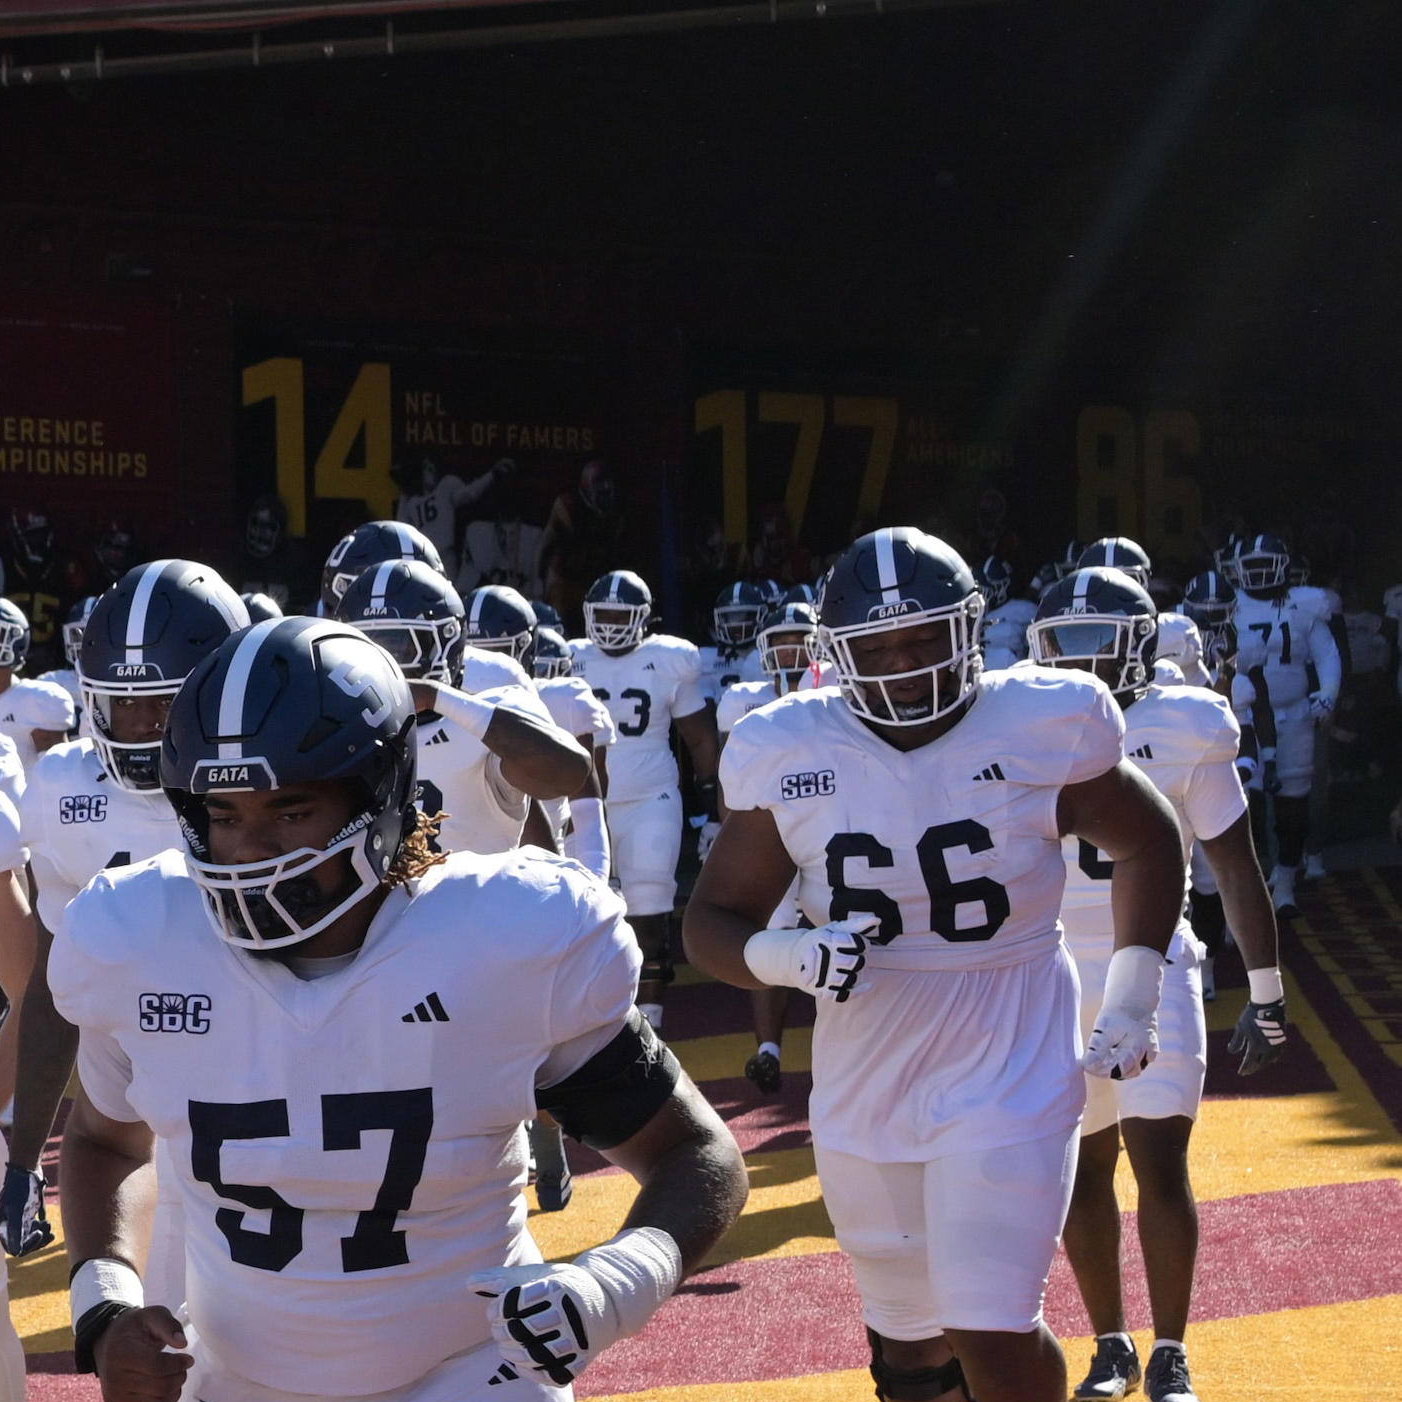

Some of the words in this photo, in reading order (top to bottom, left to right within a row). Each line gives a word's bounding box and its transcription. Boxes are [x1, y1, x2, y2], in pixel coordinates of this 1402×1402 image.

[405, 391, 446, 416] NFL
[242, 357, 400, 539] 14
[405, 420, 463, 446] HALL
[471, 424, 499, 448] OF
[506, 423, 595, 451] FAMERS
[694, 389, 900, 558] 177
[1076, 406, 1203, 556] 86
[363, 607, 389, 616] GATA
[879, 603, 909, 618] GATA
[1247, 622, 1293, 666] 71
[116, 665, 147, 677] GATA
[208, 766, 249, 783] GATA
[781, 769, 836, 800] SBC
[60, 794, 108, 825] SBC
[825, 818, 1011, 946] 66
[138, 991, 212, 1035] SBC
[188, 1086, 433, 1273] 57
